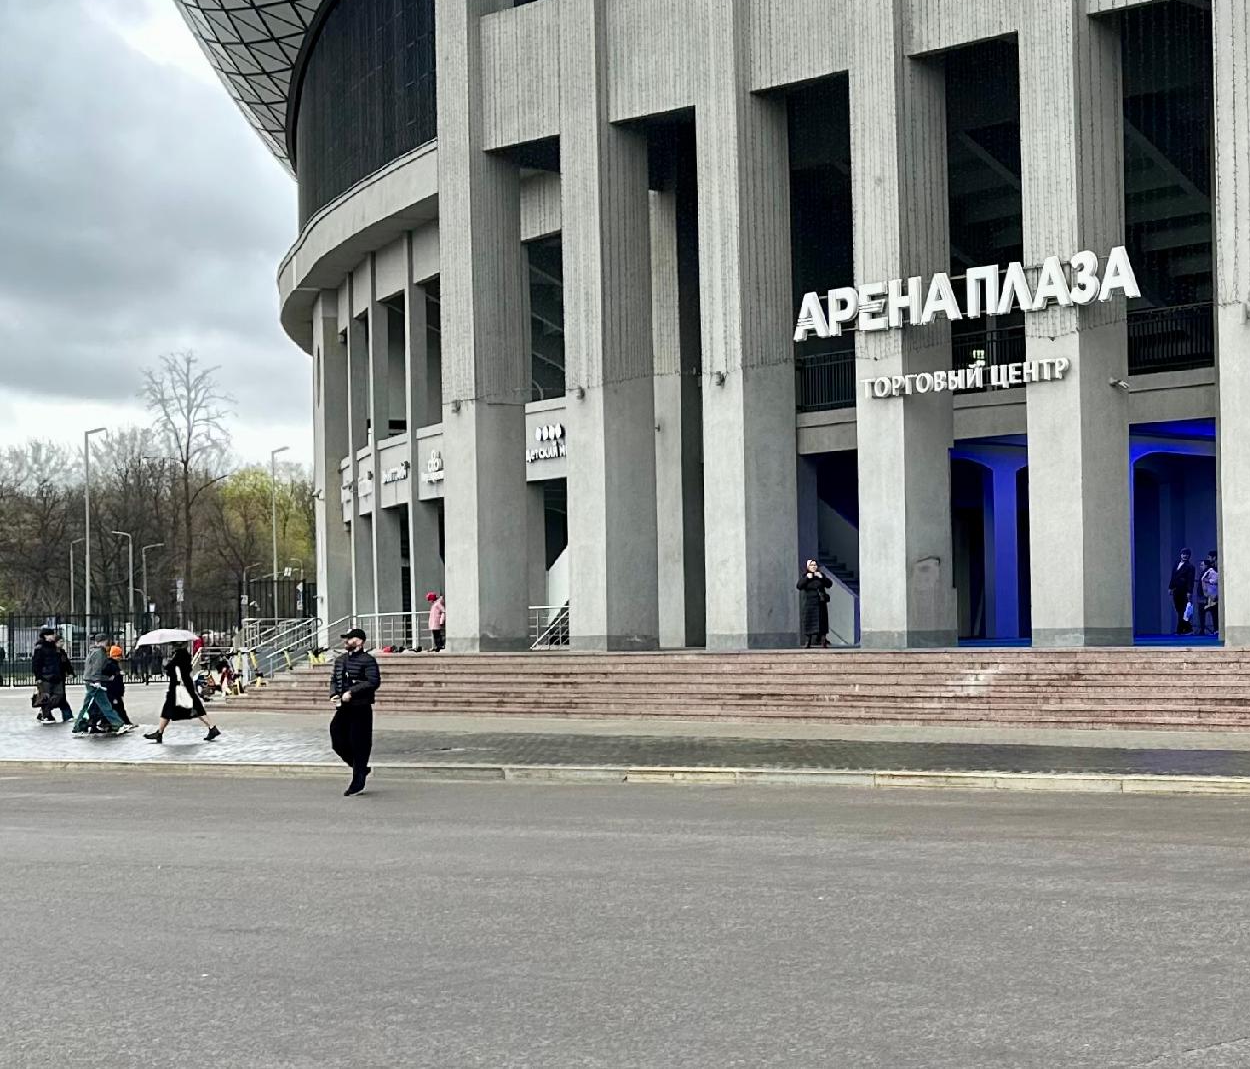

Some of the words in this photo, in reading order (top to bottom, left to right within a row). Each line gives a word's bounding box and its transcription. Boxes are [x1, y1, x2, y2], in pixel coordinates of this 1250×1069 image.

[793, 272, 963, 342] АРЕНА
[965, 245, 1141, 320] ПЛАЗА
[862, 363, 984, 400] ТОРГОВЫЙ
[990, 357, 1070, 389] ЦЕНТР
